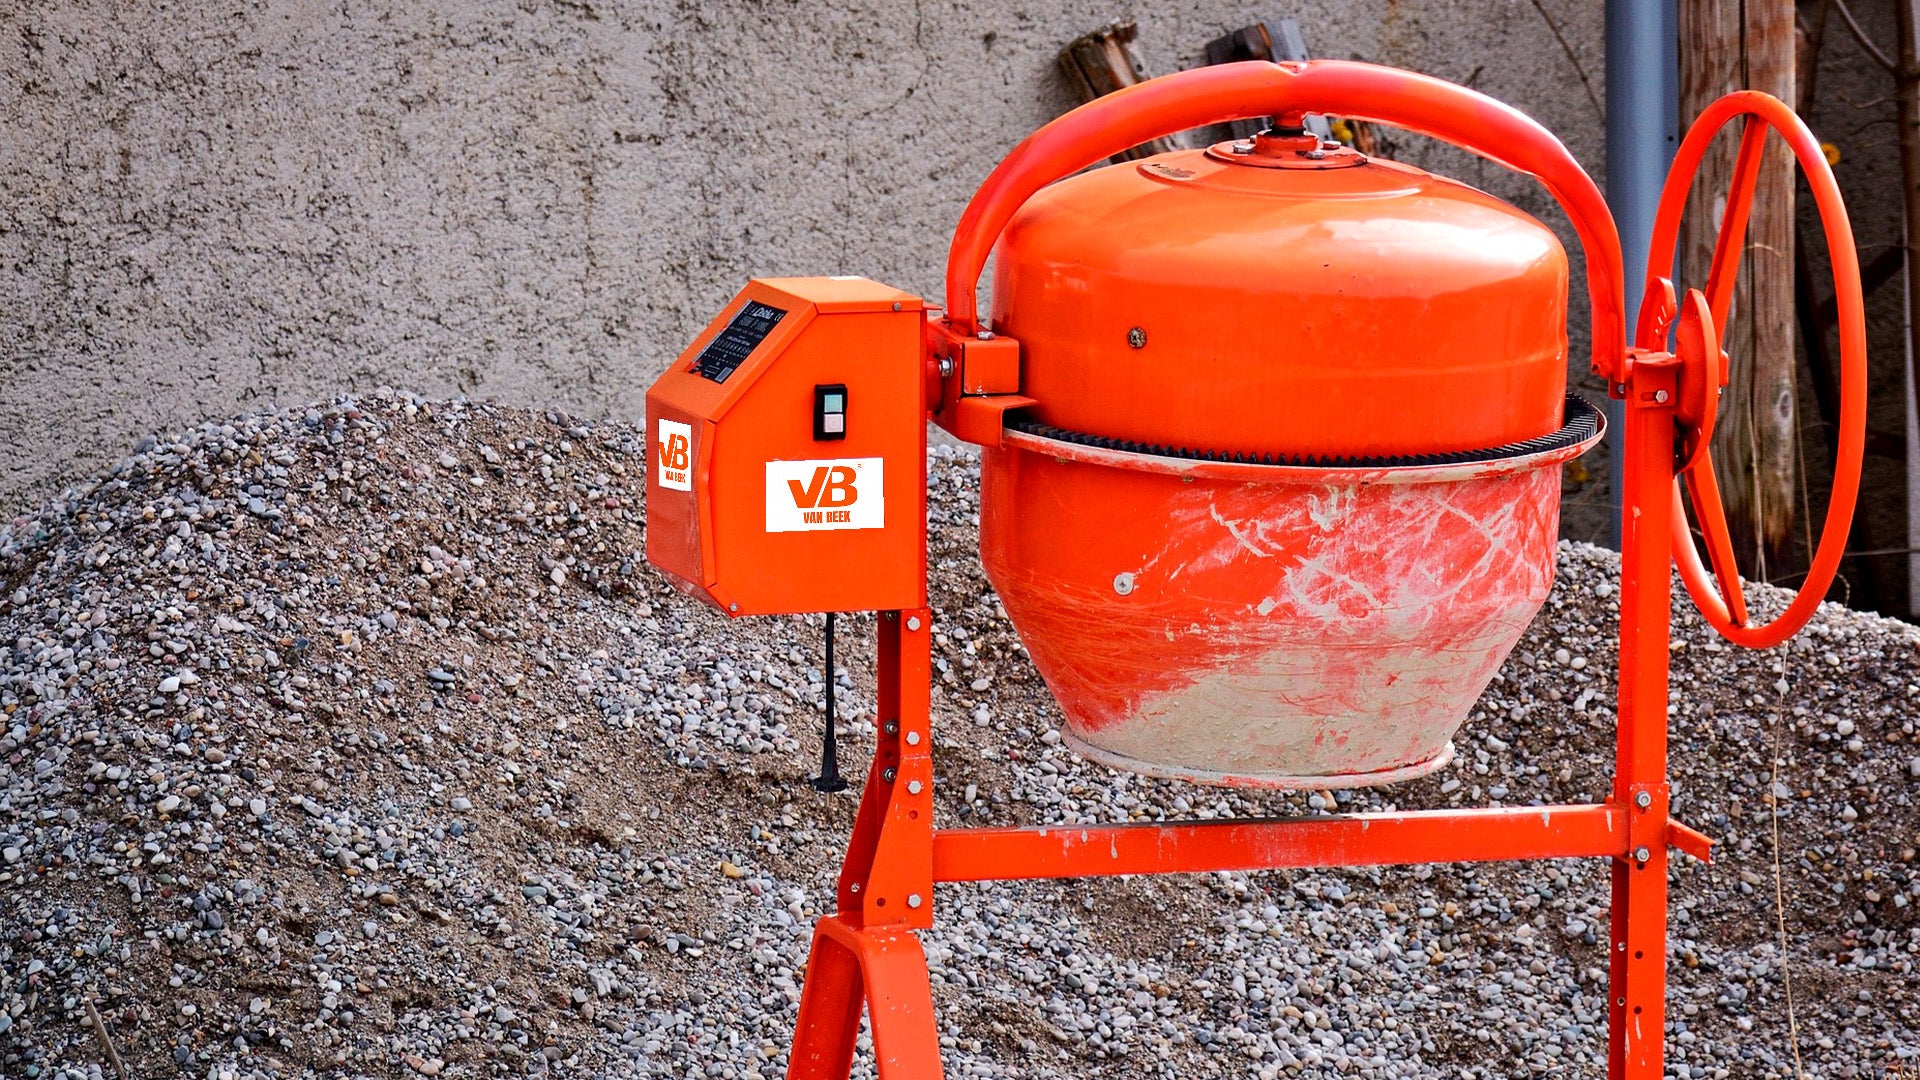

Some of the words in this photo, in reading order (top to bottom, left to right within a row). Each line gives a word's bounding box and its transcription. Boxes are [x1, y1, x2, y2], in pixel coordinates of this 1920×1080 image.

[659, 433, 688, 470] VB
[787, 466, 858, 508] VB
[803, 511, 823, 524] VAN
[826, 510, 851, 523] BEEK
